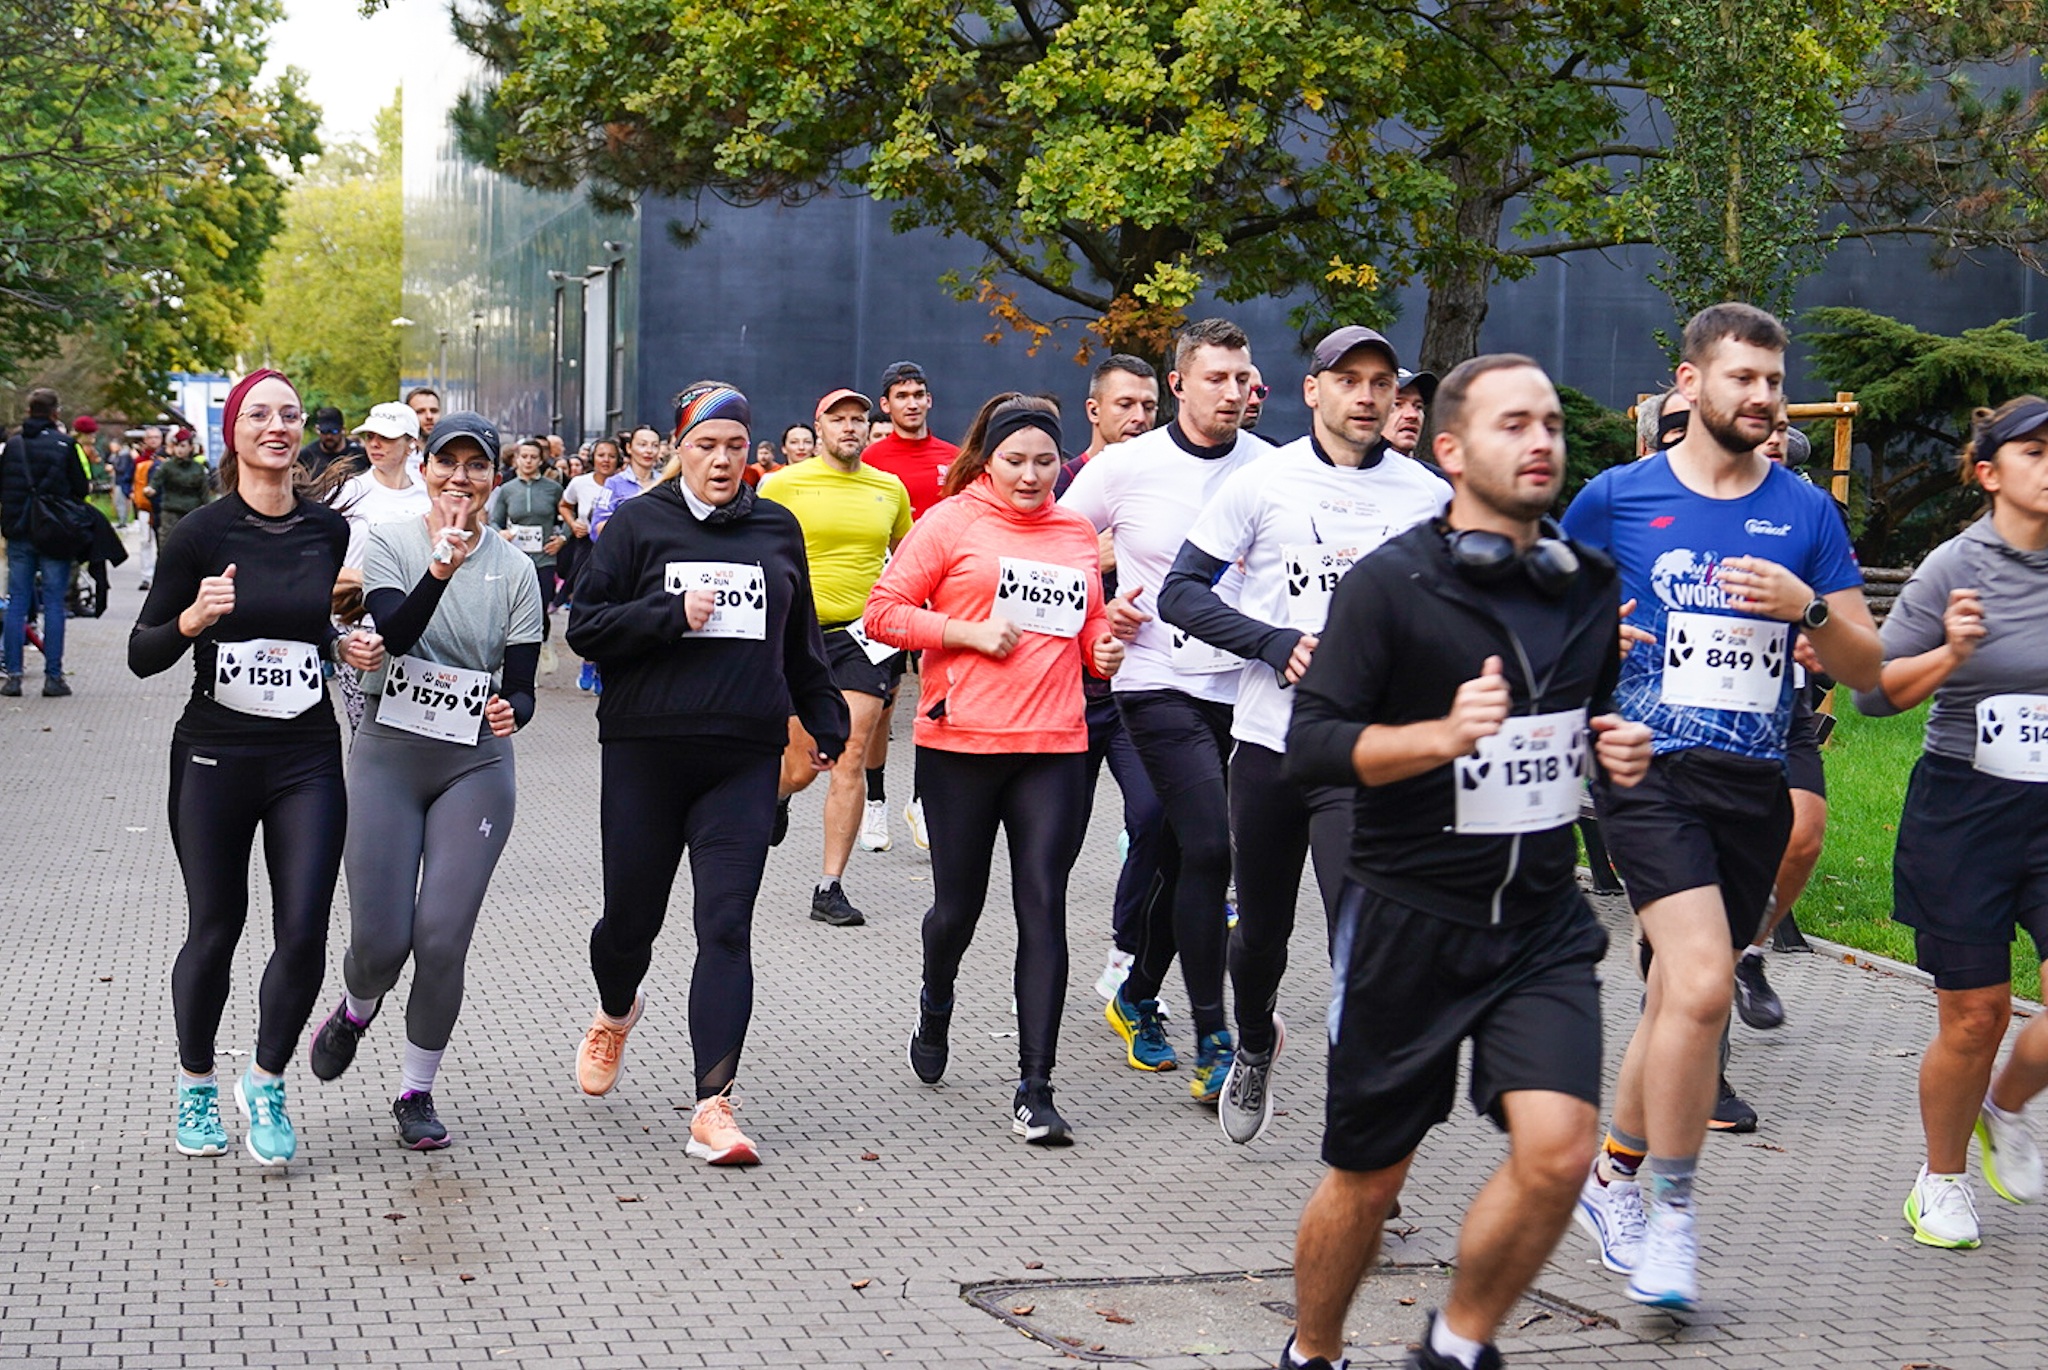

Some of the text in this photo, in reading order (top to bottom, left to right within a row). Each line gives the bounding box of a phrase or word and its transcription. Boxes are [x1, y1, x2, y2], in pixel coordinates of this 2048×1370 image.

[713, 578, 729, 586] RUN
[714, 570, 734, 578] WILD
[1318, 572, 1339, 592] 13
[716, 590, 741, 607] 30
[1022, 585, 1065, 606] 1629
[267, 656, 283, 664] RUN
[268, 647, 288, 656] WILD
[1706, 648, 1754, 671] 849
[248, 667, 292, 687] 1581
[434, 680, 452, 690] RUN
[438, 672, 458, 683] WILD
[412, 685, 458, 711] 1579
[1504, 756, 1559, 786] 1518
